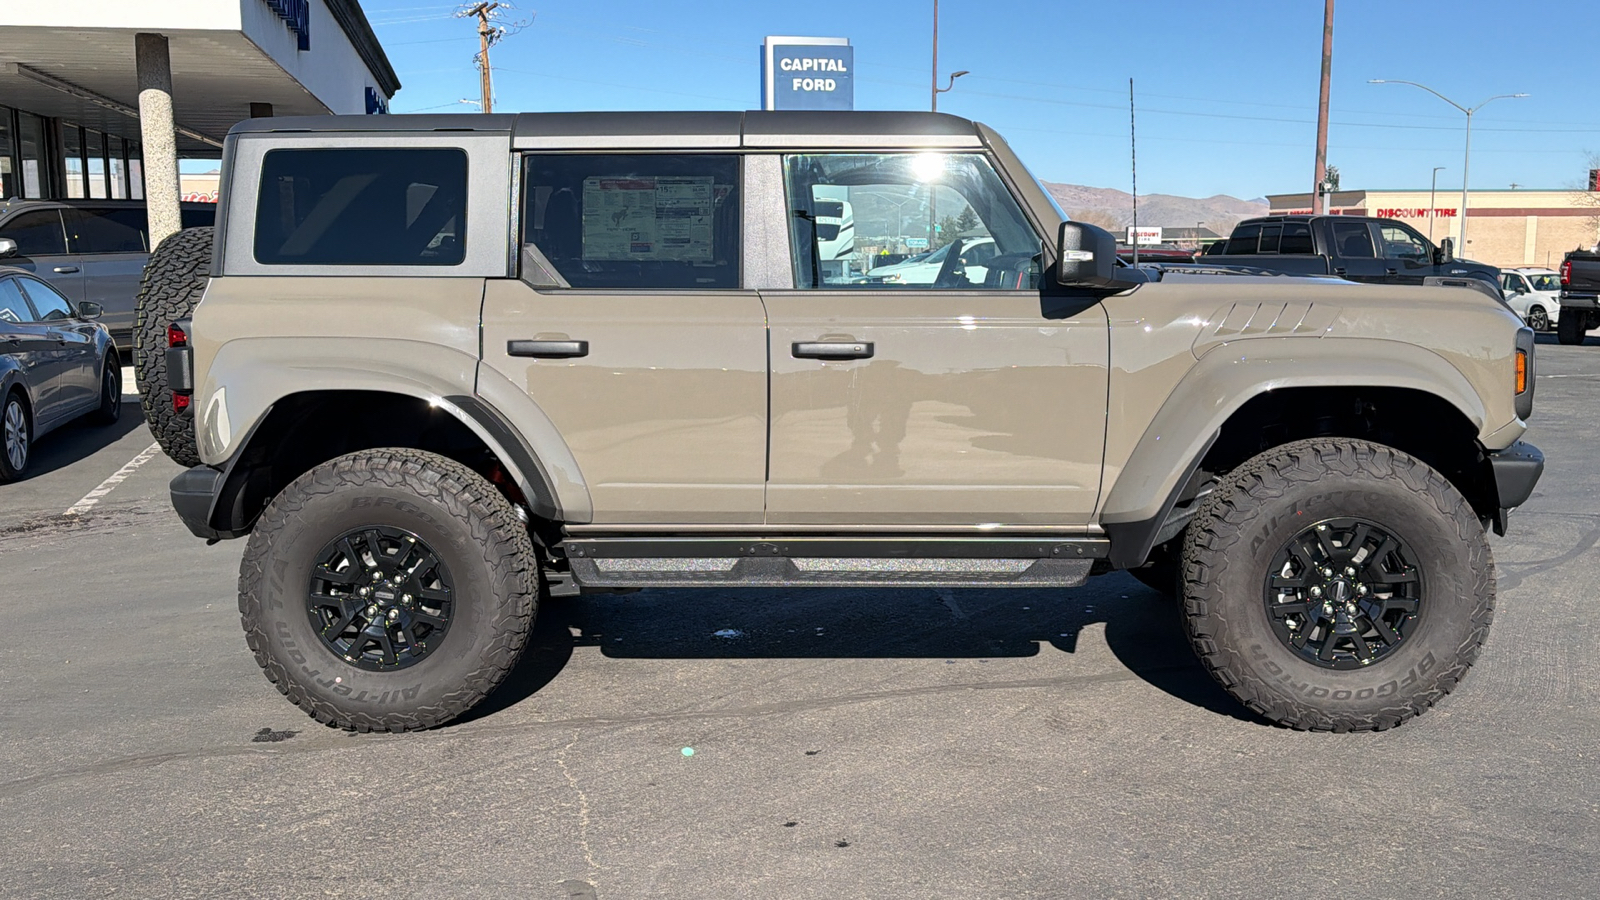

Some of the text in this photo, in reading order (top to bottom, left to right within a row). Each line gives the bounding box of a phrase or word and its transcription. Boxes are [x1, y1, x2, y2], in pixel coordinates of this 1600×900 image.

[780, 57, 847, 72] CAPITAL
[792, 78, 836, 91] FORD
[1376, 208, 1457, 218] DISCOUNT TIRE
[269, 557, 289, 611] T/A
[275, 622, 423, 704] All-Terrain
[1249, 644, 1437, 701] BFGoodrich
